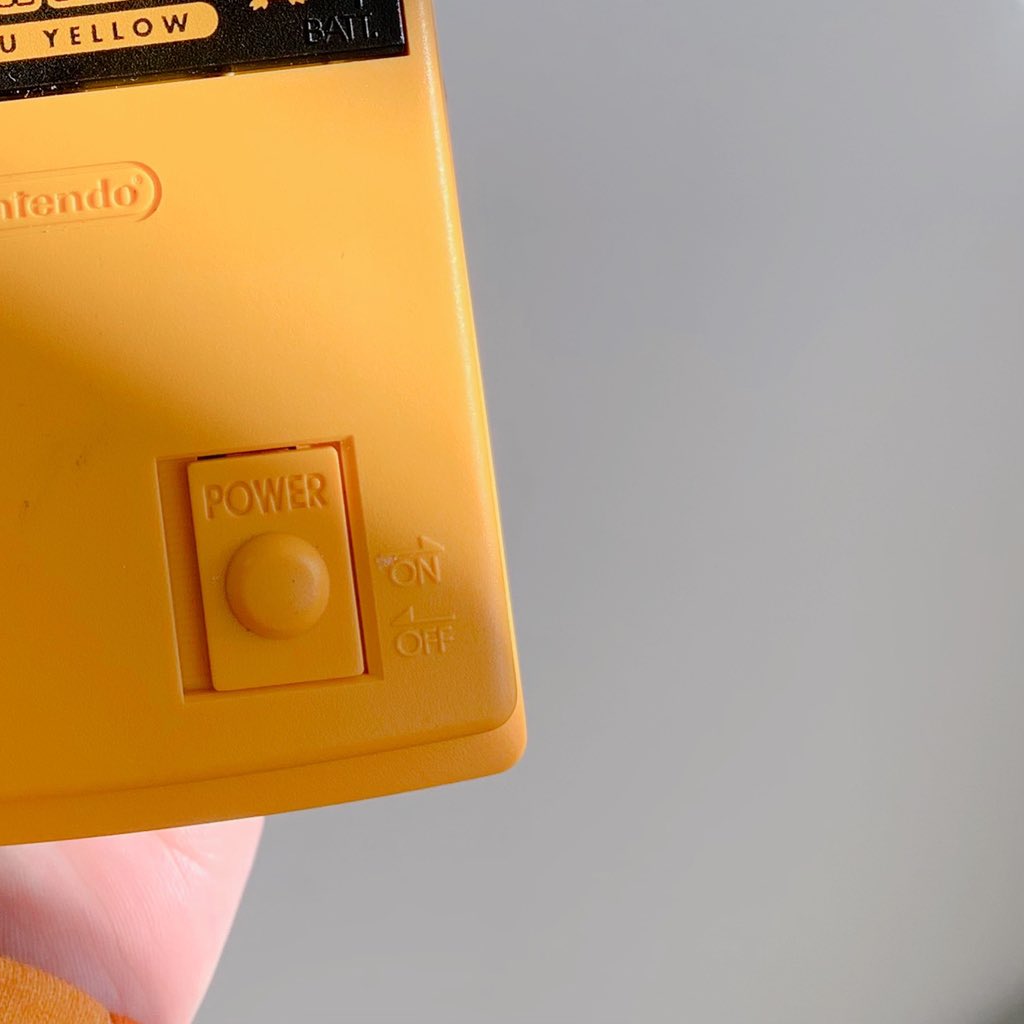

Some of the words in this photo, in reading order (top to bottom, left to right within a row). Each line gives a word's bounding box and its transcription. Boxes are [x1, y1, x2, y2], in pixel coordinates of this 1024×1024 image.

[43, 12, 190, 48] YELLOW
[203, 472, 327, 520] POWER
[389, 555, 442, 587] ON
[394, 626, 456, 658] OFF
